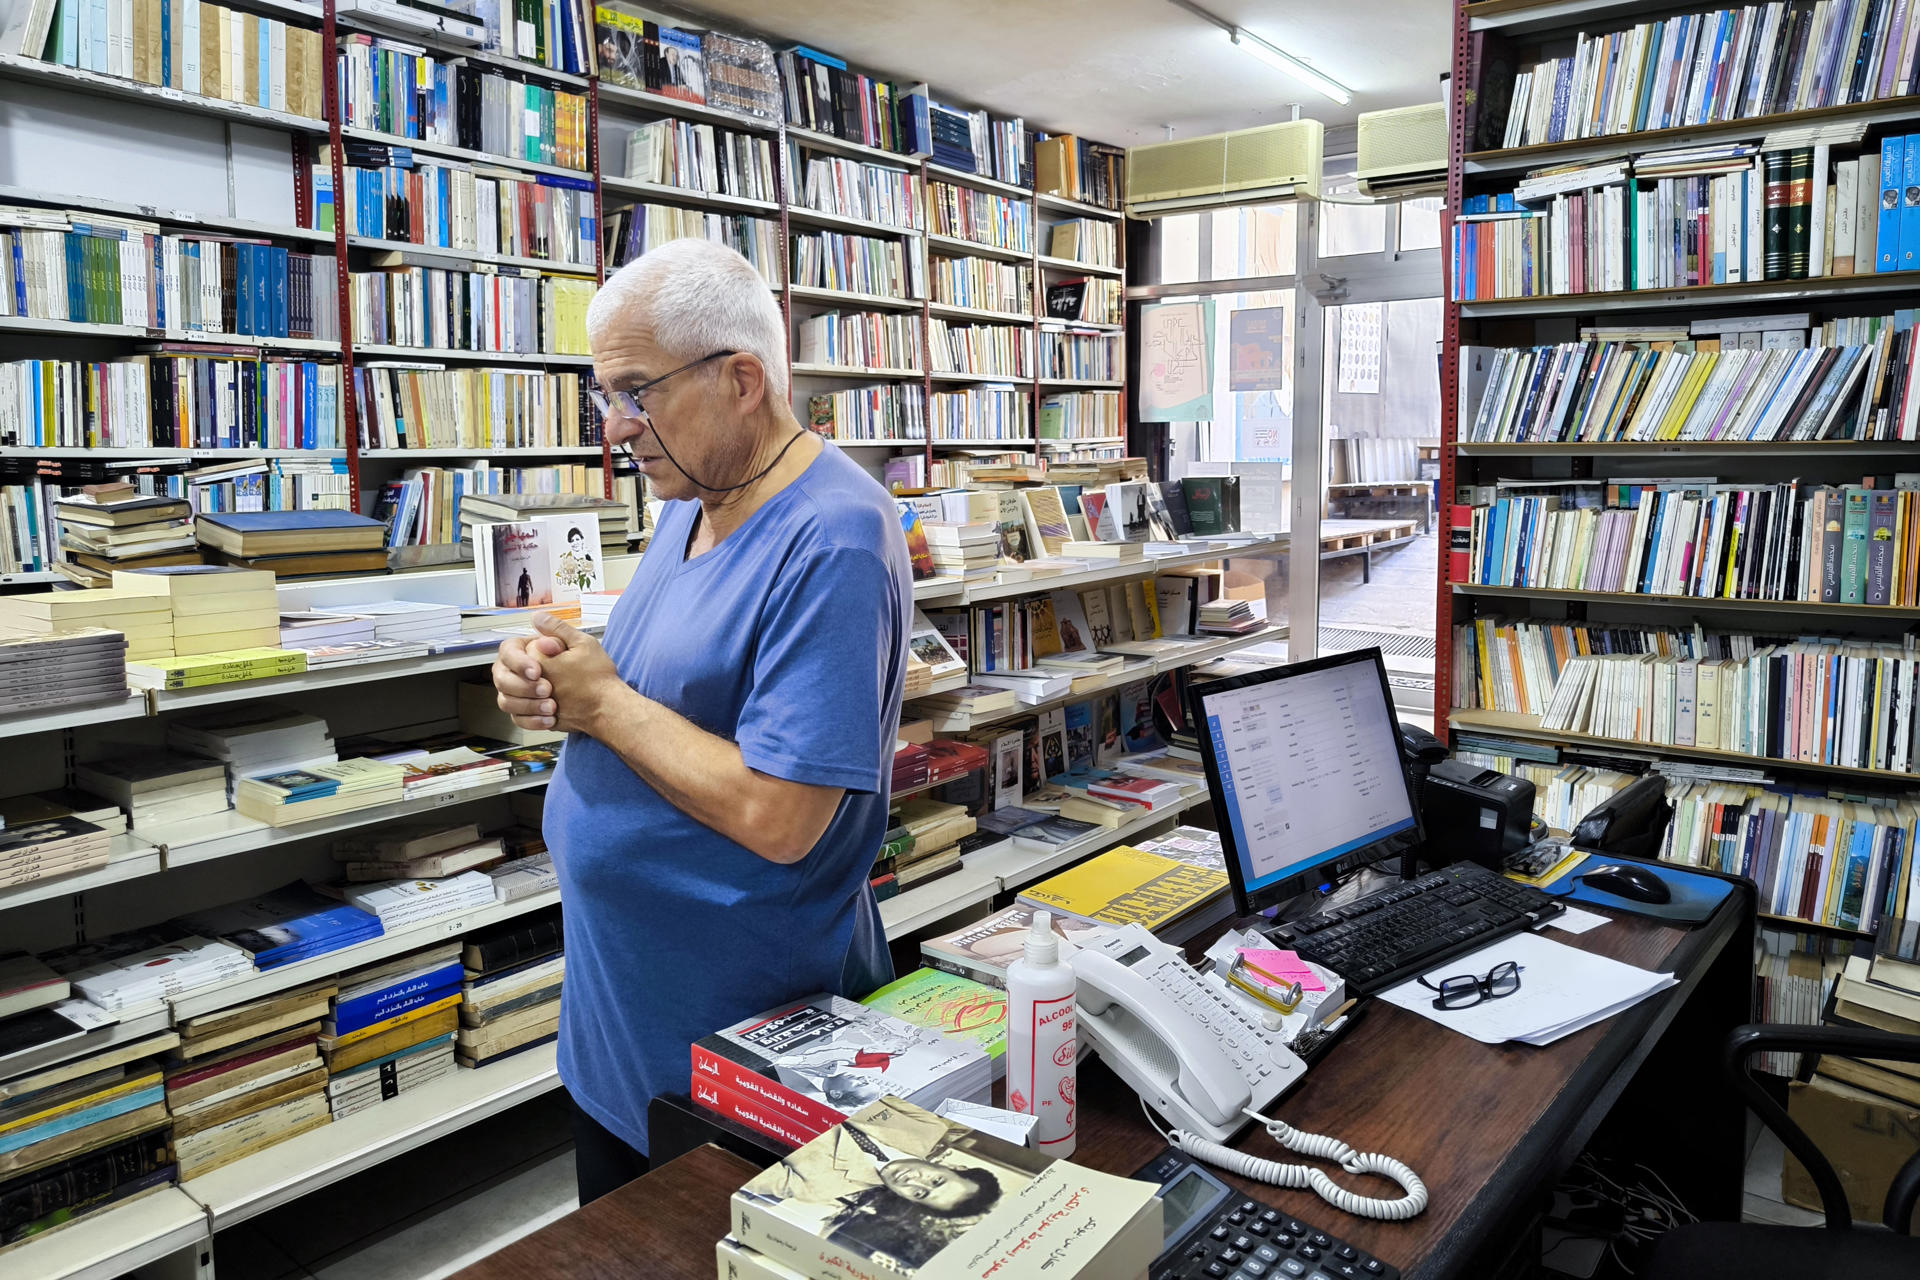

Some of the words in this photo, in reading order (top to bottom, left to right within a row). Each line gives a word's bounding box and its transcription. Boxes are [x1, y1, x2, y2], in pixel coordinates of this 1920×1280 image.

[983, 1257, 1008, 1278] صعود
[1008, 1232, 1043, 1257] وسقوط
[1038, 1209, 1069, 1231] سورية
[1040, 1248, 1067, 1271] كارل
